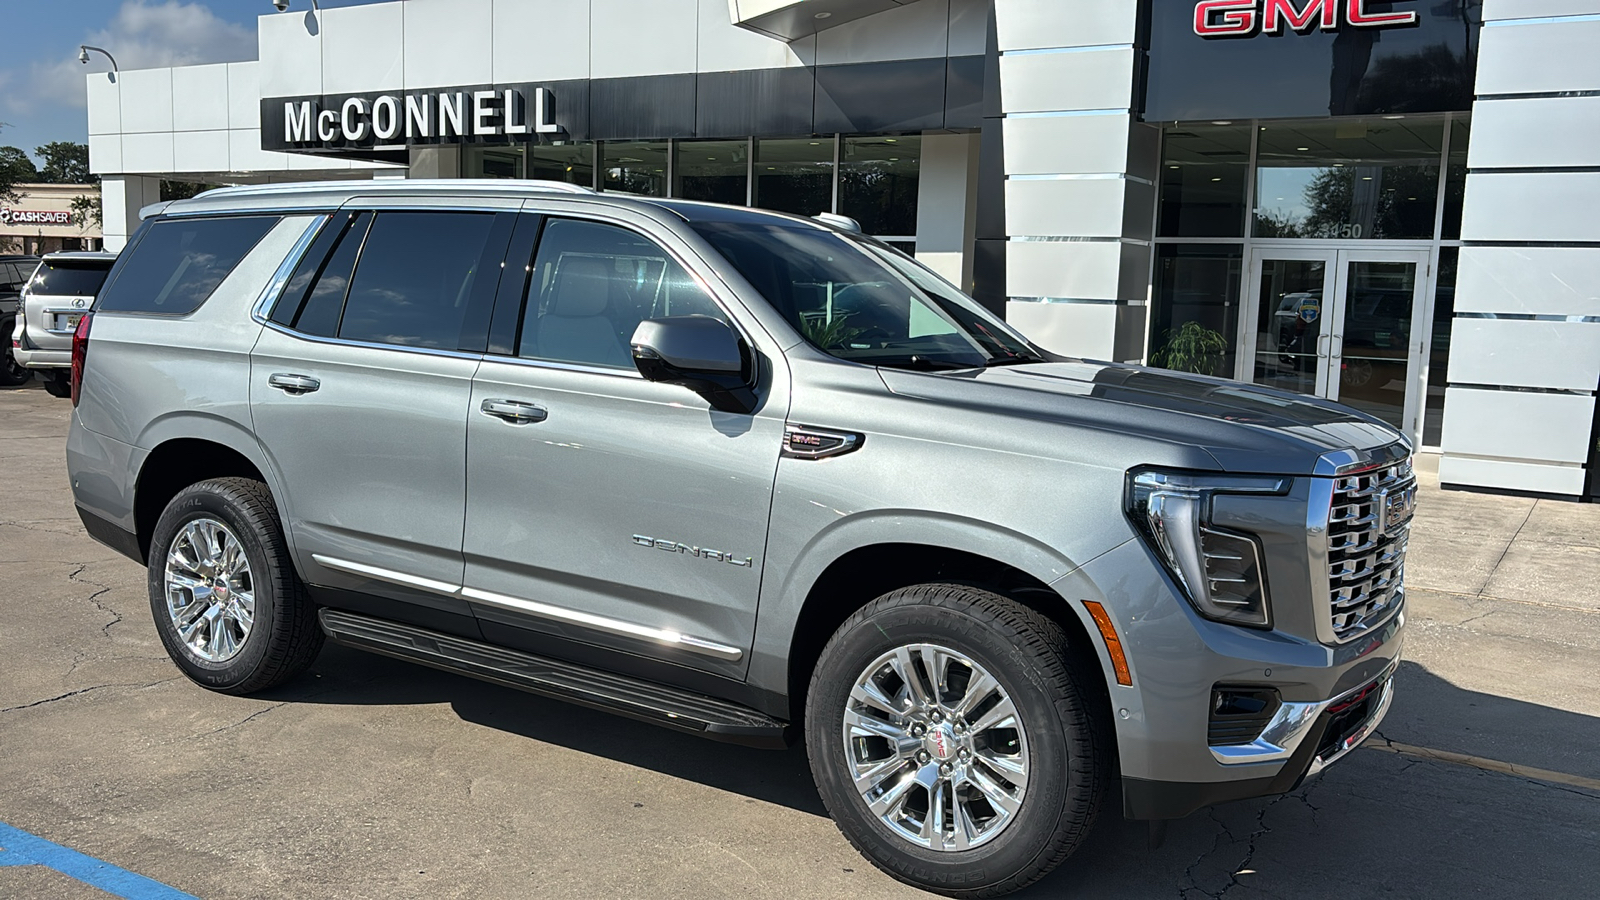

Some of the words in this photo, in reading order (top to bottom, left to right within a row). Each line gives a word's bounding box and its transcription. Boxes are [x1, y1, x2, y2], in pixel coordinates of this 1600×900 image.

[1193, 0, 1417, 36] GMC
[12, 211, 69, 223] CASHSAVER
[792, 434, 820, 446] GMC
[632, 533, 753, 568] DENALI
